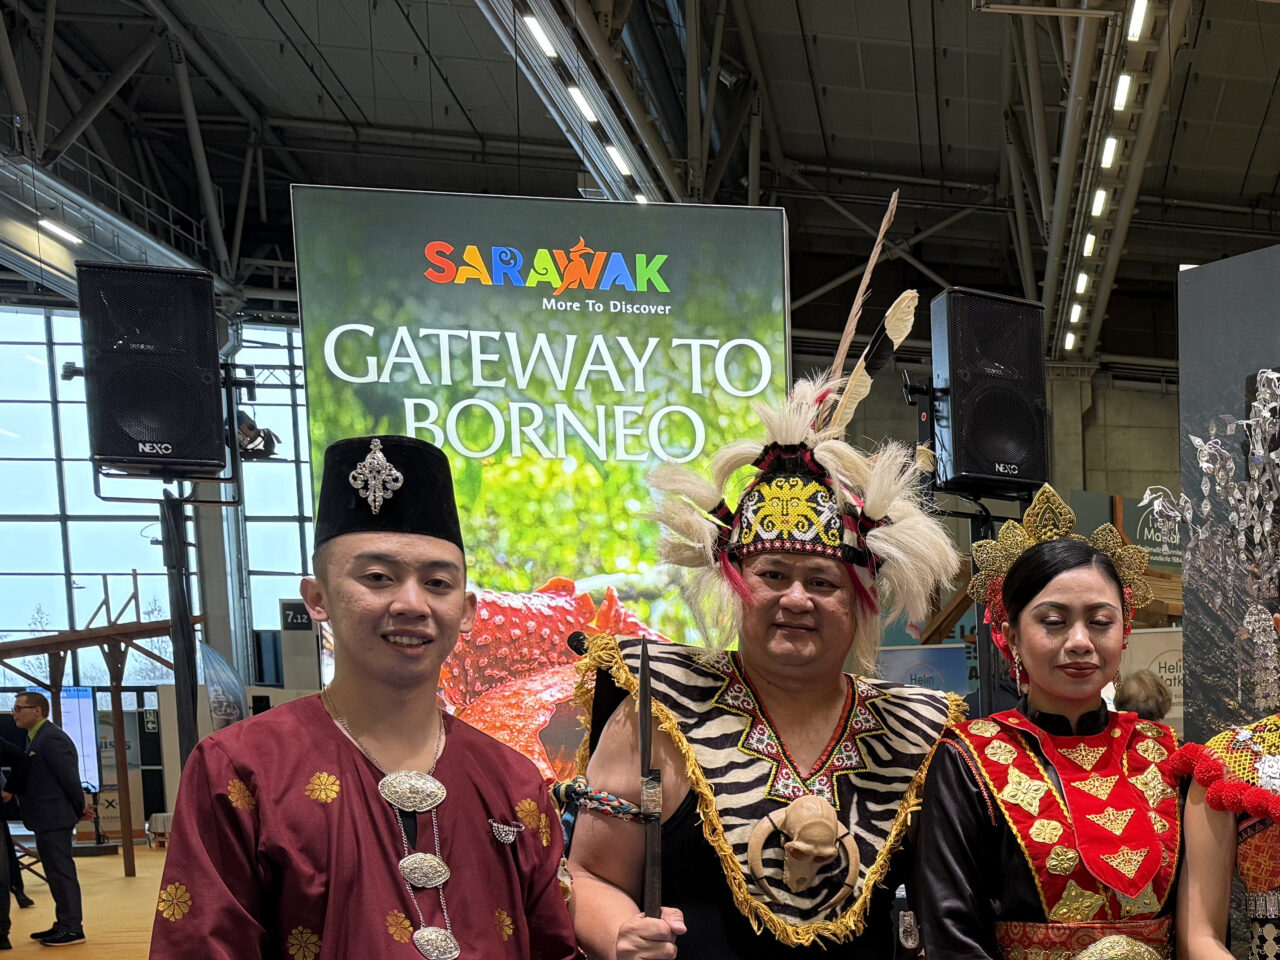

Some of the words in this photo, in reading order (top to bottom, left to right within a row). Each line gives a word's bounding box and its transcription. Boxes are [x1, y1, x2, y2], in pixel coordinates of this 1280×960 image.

[424, 236, 670, 296] SARAWAK
[543, 298, 580, 312] More
[586, 300, 603, 312] To
[610, 301, 671, 315] Discover
[324, 324, 658, 393] GATEWAY
[672, 339, 772, 398] TO
[404, 397, 706, 464] BORNEO
[138, 442, 172, 455] NEXO
[995, 463, 1019, 475] NEXO
[285, 610, 309, 623] 7.12
[1158, 660, 1183, 674] Heli
